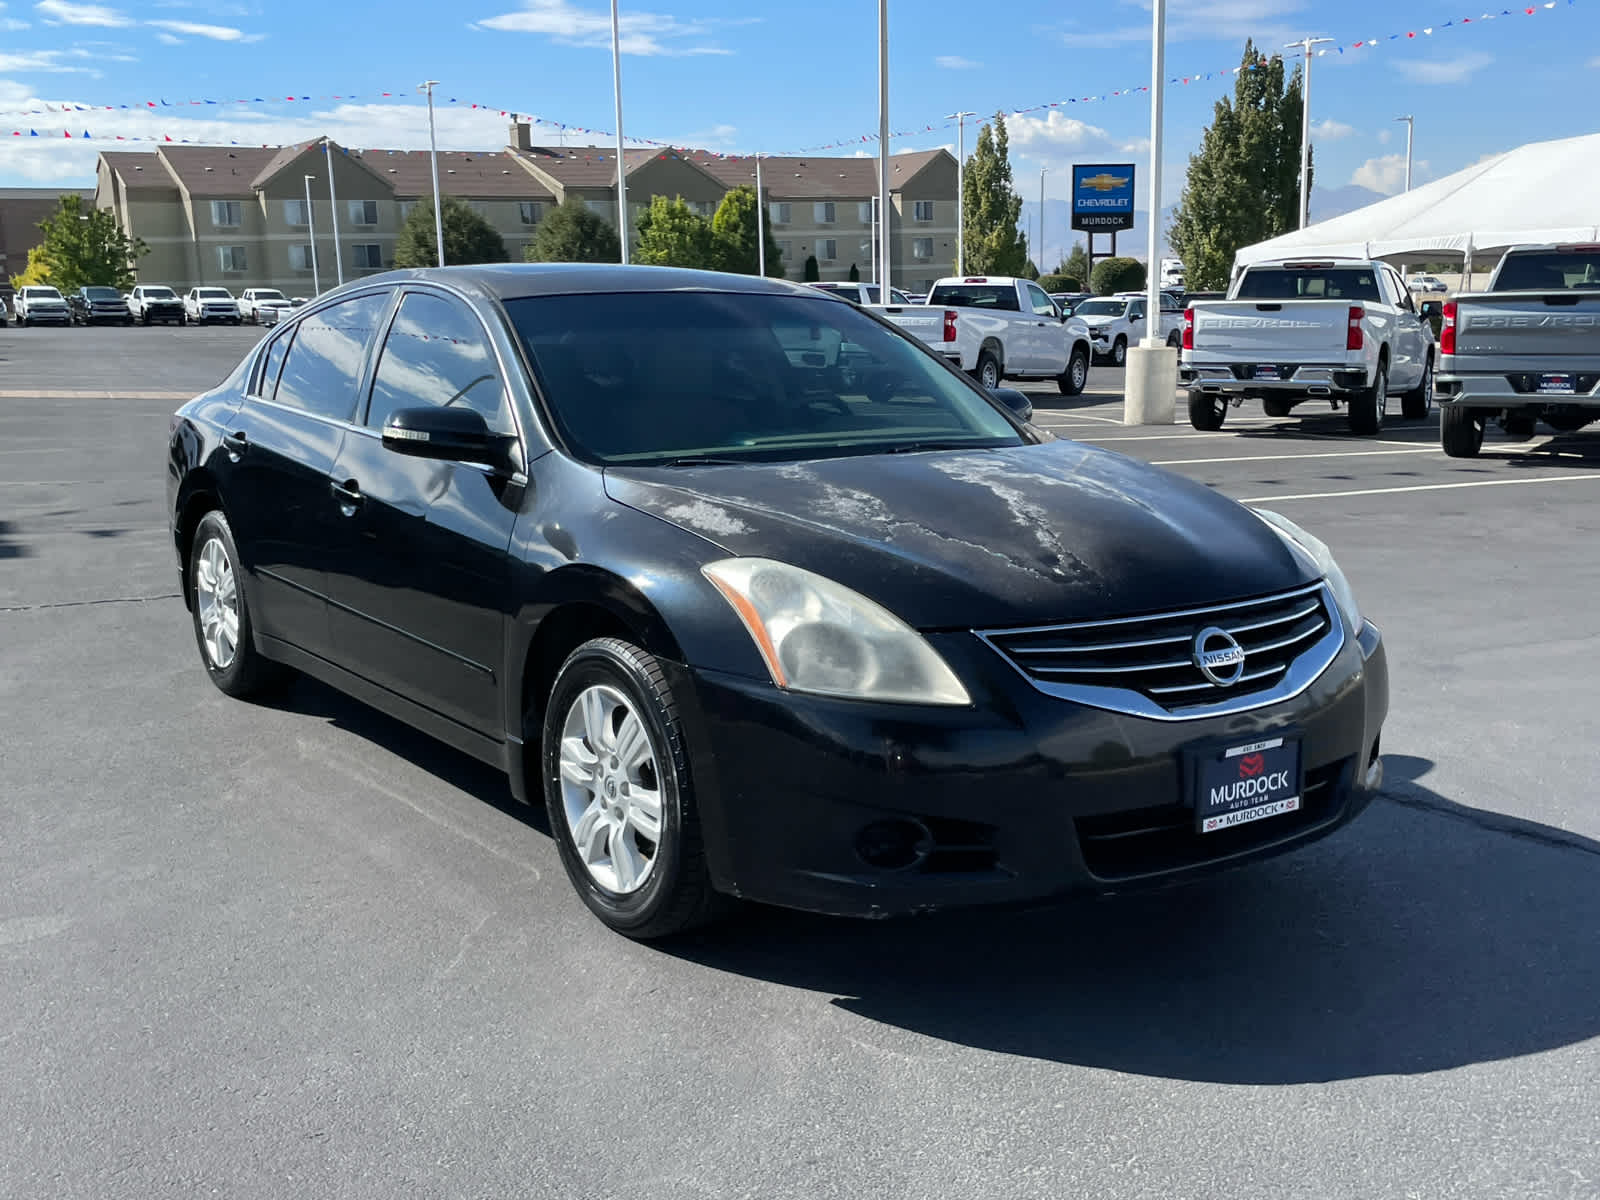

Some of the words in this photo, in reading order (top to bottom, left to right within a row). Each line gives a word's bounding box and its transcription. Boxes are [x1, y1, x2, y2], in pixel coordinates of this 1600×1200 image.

[1078, 199, 1128, 207] CHEVROLET
[1081, 217, 1124, 225] MURDOCK
[1470, 316, 1600, 327] CHEVRO
[1203, 650, 1243, 664] NISSAN
[1210, 770, 1289, 806] MURDOCK
[1230, 799, 1249, 809] AUTO
[1226, 803, 1279, 825] MURDOCK
